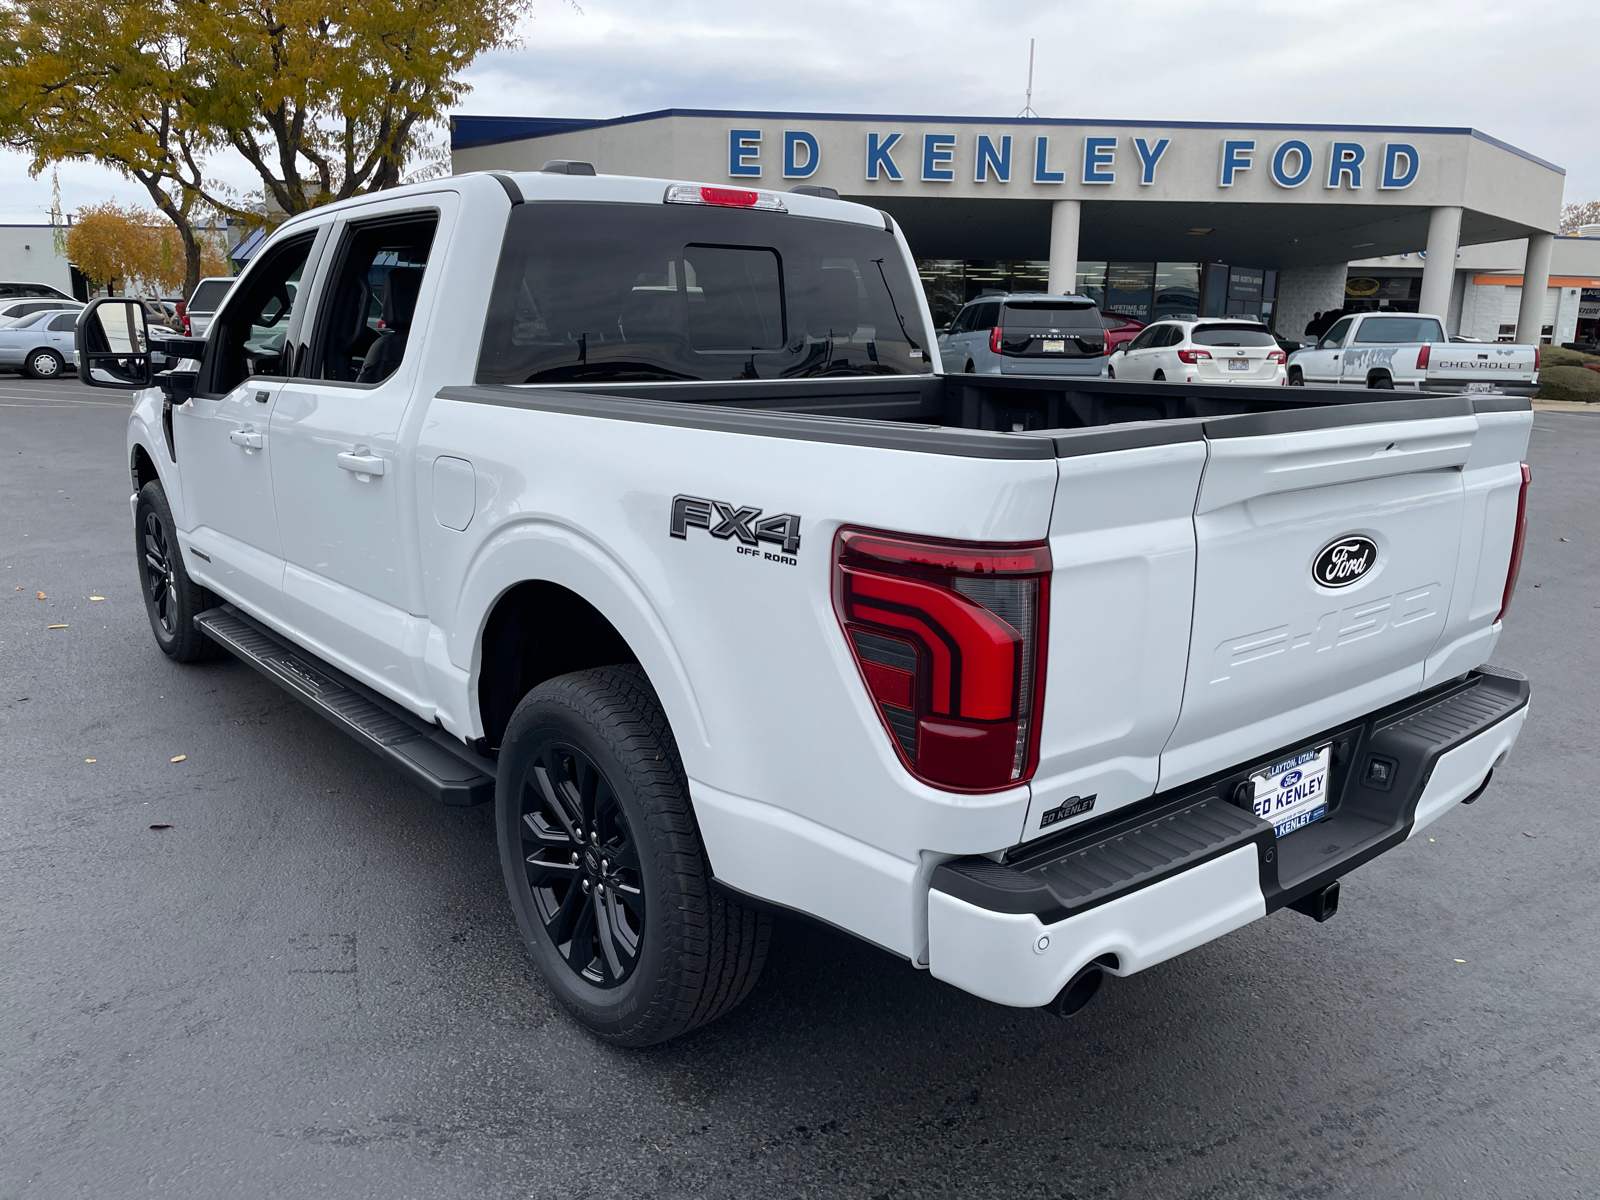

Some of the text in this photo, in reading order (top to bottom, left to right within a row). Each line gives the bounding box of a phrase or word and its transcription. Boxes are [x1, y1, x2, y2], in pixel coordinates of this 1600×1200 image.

[728, 128, 1420, 190] ED KENLEY FORD
[1439, 361, 1525, 370] CHEVROLET
[669, 493, 802, 556] FX4
[736, 546, 798, 566] OFF ROAD
[1325, 543, 1369, 581] Ford
[1209, 581, 1442, 684] F-150
[1298, 750, 1315, 765] UTAH
[1276, 774, 1324, 810] KENLEY
[1042, 798, 1096, 826] ED KENLEY
[1279, 811, 1311, 836] KENLEY
